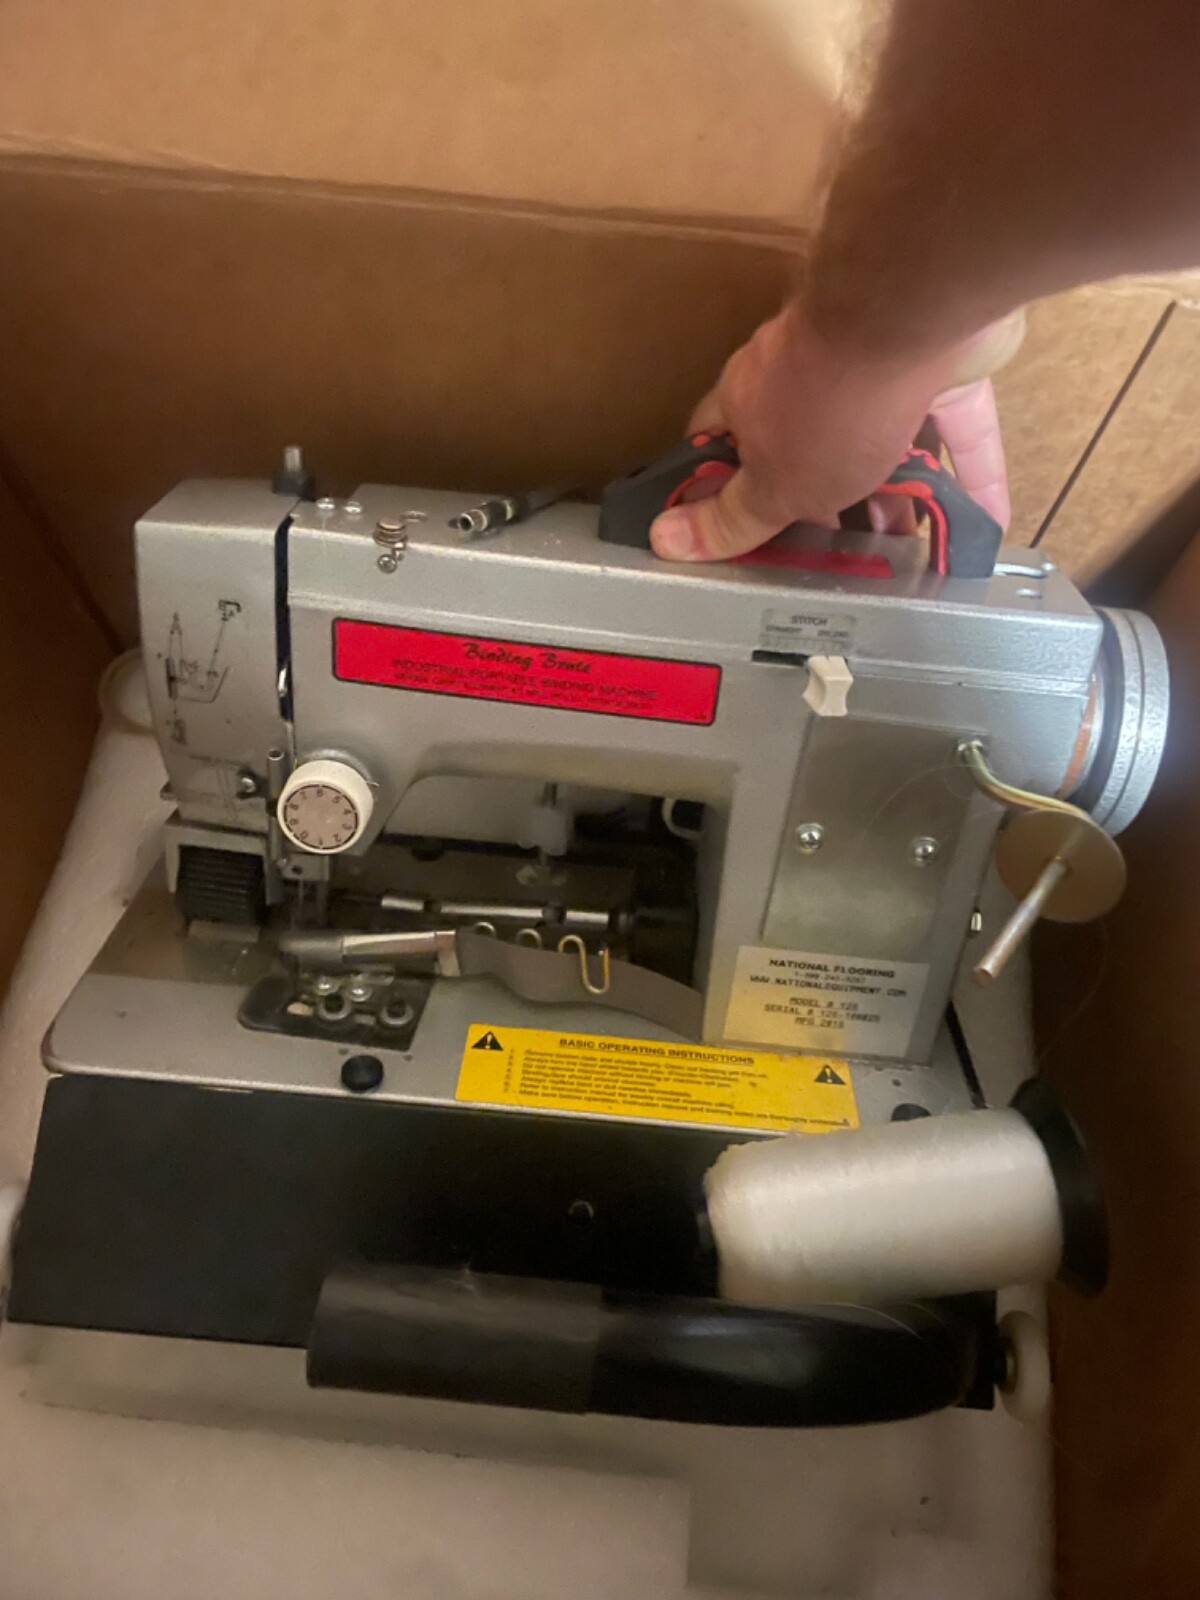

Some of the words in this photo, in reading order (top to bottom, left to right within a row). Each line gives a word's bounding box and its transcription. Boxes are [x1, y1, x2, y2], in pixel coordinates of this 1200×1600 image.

[791, 615, 828, 626] STITCH
[462, 642, 533, 671] Binding
[539, 652, 592, 673] Brute
[769, 959, 829, 973] NATIONAL
[833, 965, 895, 979] FLOORING
[764, 1003, 801, 1015] SERIAL
[789, 996, 821, 1009] MODEL
[559, 1038, 595, 1050] BASIC
[598, 1041, 666, 1056] OPERATING
[668, 1048, 755, 1064] INSTRUCTIONS
